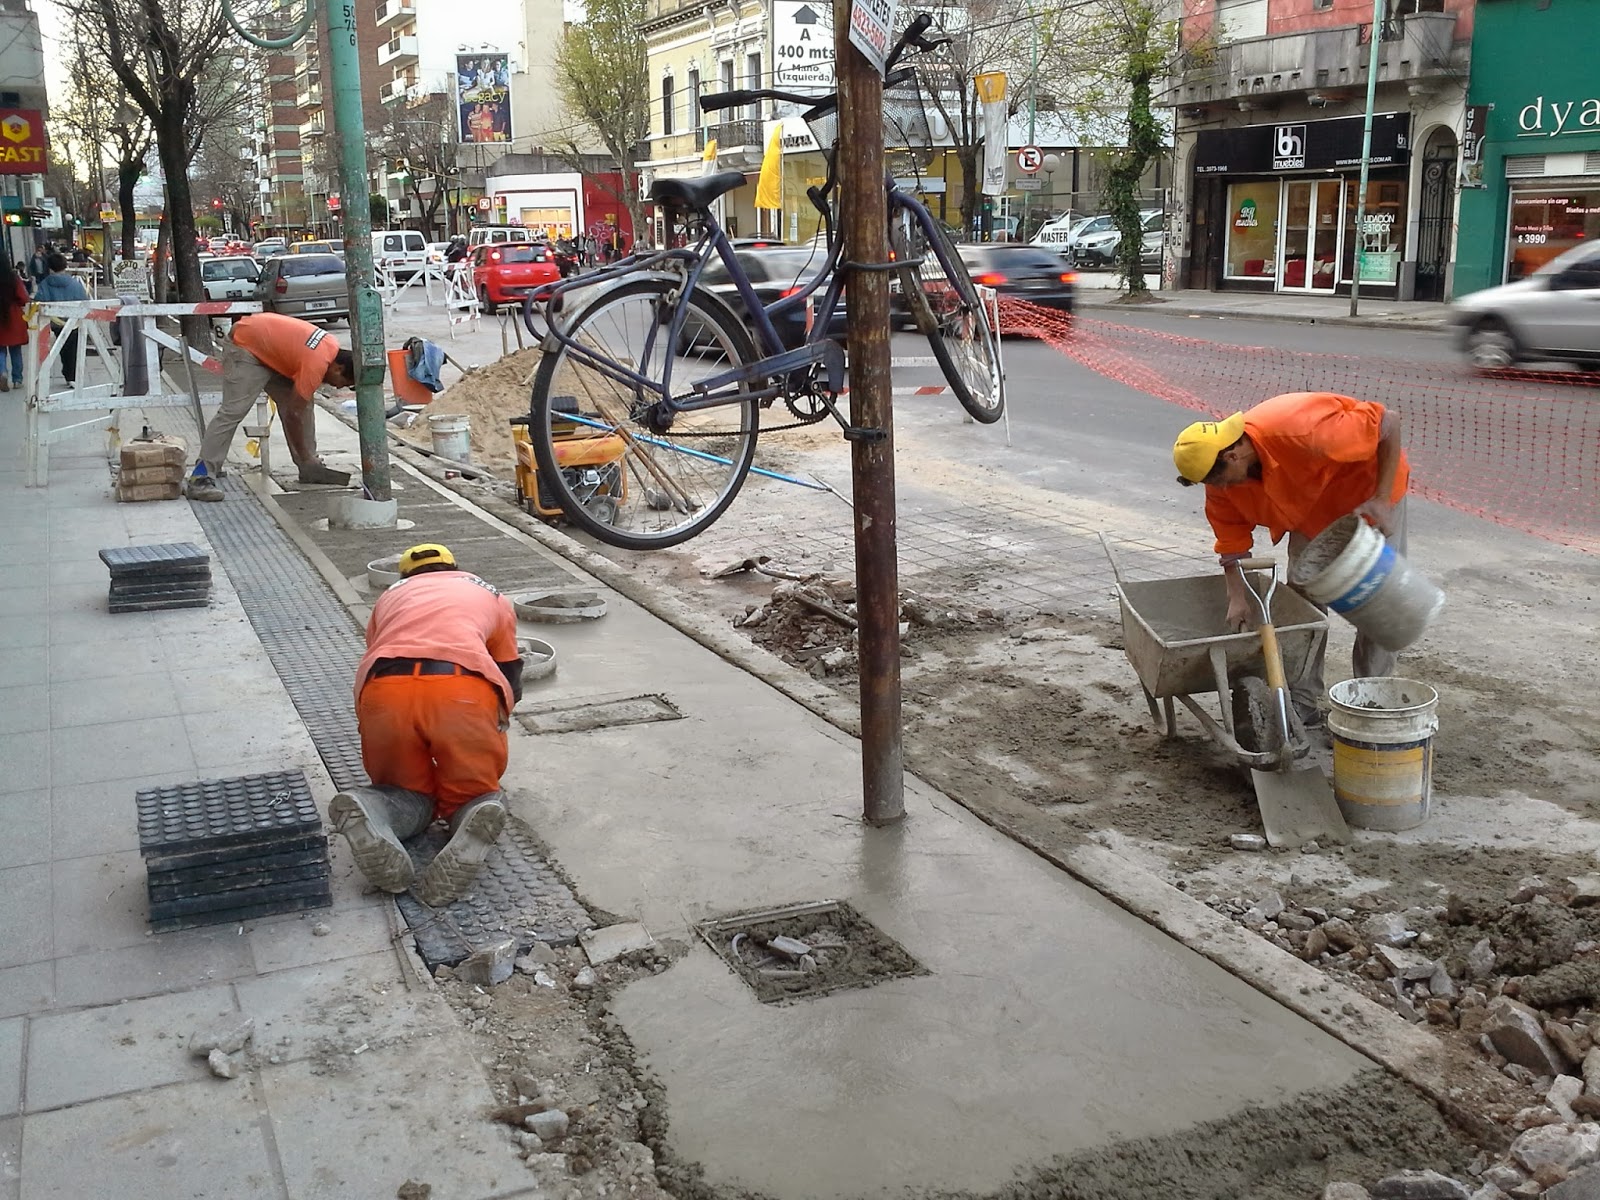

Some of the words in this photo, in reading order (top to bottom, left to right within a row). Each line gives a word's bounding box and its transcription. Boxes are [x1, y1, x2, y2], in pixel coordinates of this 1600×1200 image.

[800, 28, 811, 41] A
[778, 45, 804, 58] 400
[809, 46, 835, 59] mts
[1519, 96, 1600, 137] dya
[1278, 127, 1302, 156] bh
[0, 146, 43, 162] FAST
[1274, 158, 1304, 168] muebles
[1354, 212, 1395, 224] LUIDACIÓN
[1367, 223, 1391, 232] STOCK
[1040, 231, 1068, 243] MASTER
[1525, 234, 1546, 243] 3990
